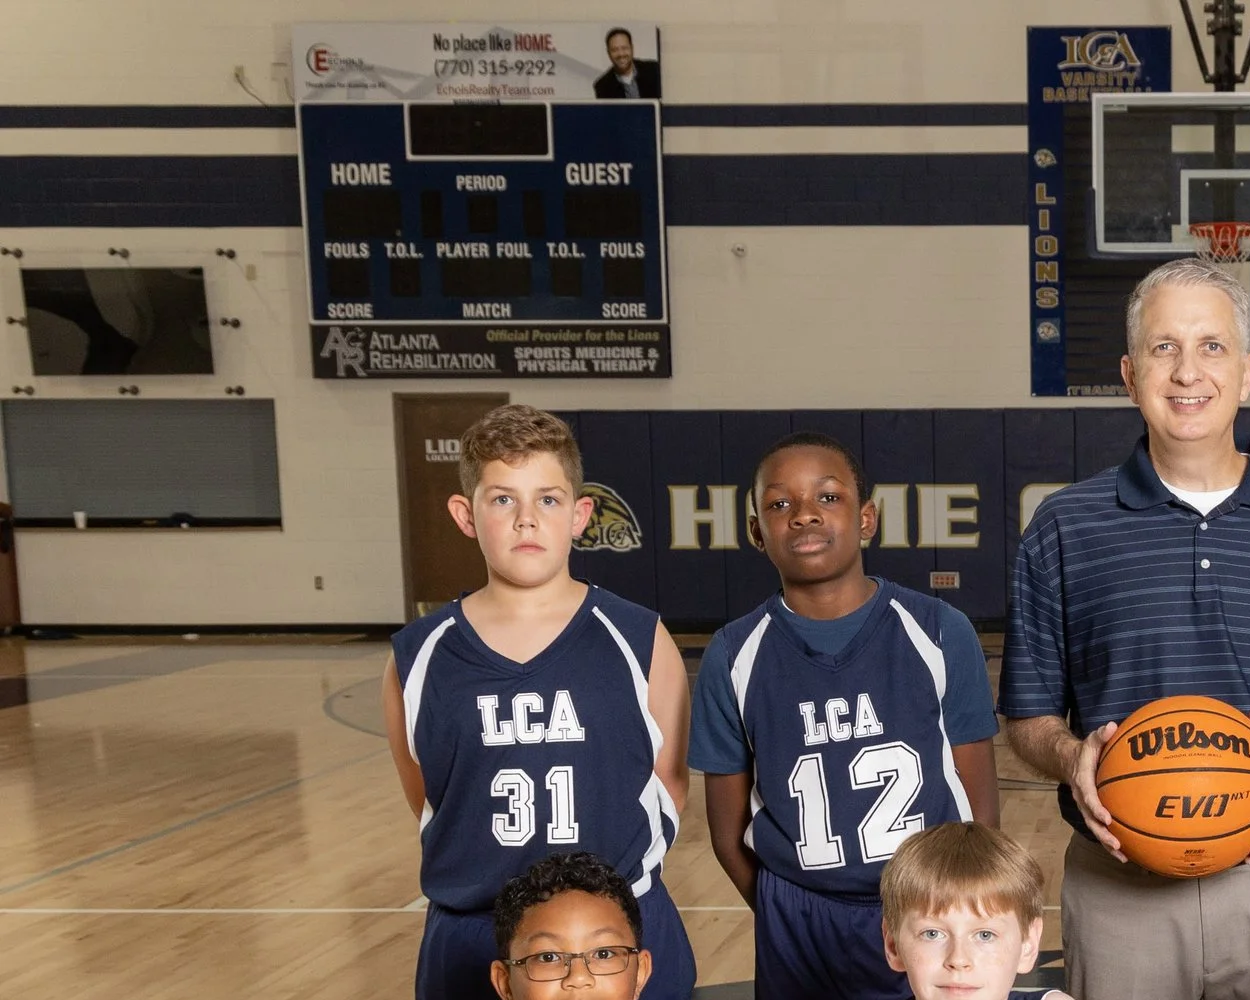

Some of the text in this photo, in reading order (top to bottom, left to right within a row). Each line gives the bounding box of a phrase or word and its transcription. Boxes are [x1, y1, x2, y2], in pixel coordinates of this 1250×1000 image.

[433, 33, 557, 54] No place like HOME.
[434, 59, 556, 77] (770) 315-9292
[1060, 71, 1137, 86] VARSITY
[330, 162, 392, 185] HOME
[565, 162, 633, 185] GUEST
[456, 175, 507, 191] PERIOD
[324, 243, 370, 258] FOULS
[384, 243, 424, 258] T.O.L.
[436, 242, 532, 258] PLAYER FOUL
[547, 243, 586, 258] T.O.L.
[600, 243, 645, 258] FOULS
[1035, 182, 1059, 310] LIONS
[327, 303, 374, 318] SCORE
[462, 303, 512, 318] MATCH
[602, 303, 648, 318] SCORE
[369, 332, 440, 350] ATLANTA
[486, 330, 660, 341] Official Provider for the Lions
[369, 352, 496, 369] REHABILITATION
[514, 347, 659, 359] SPORTS MEDICINE &
[517, 360, 657, 373] PHYSICAL THERAPY
[667, 484, 981, 550] HME
[477, 690, 585, 746] LCA
[800, 693, 883, 746] LCA
[490, 766, 580, 847] 31
[788, 741, 925, 871] 12
[1155, 789, 1250, 818] EVO NXT
